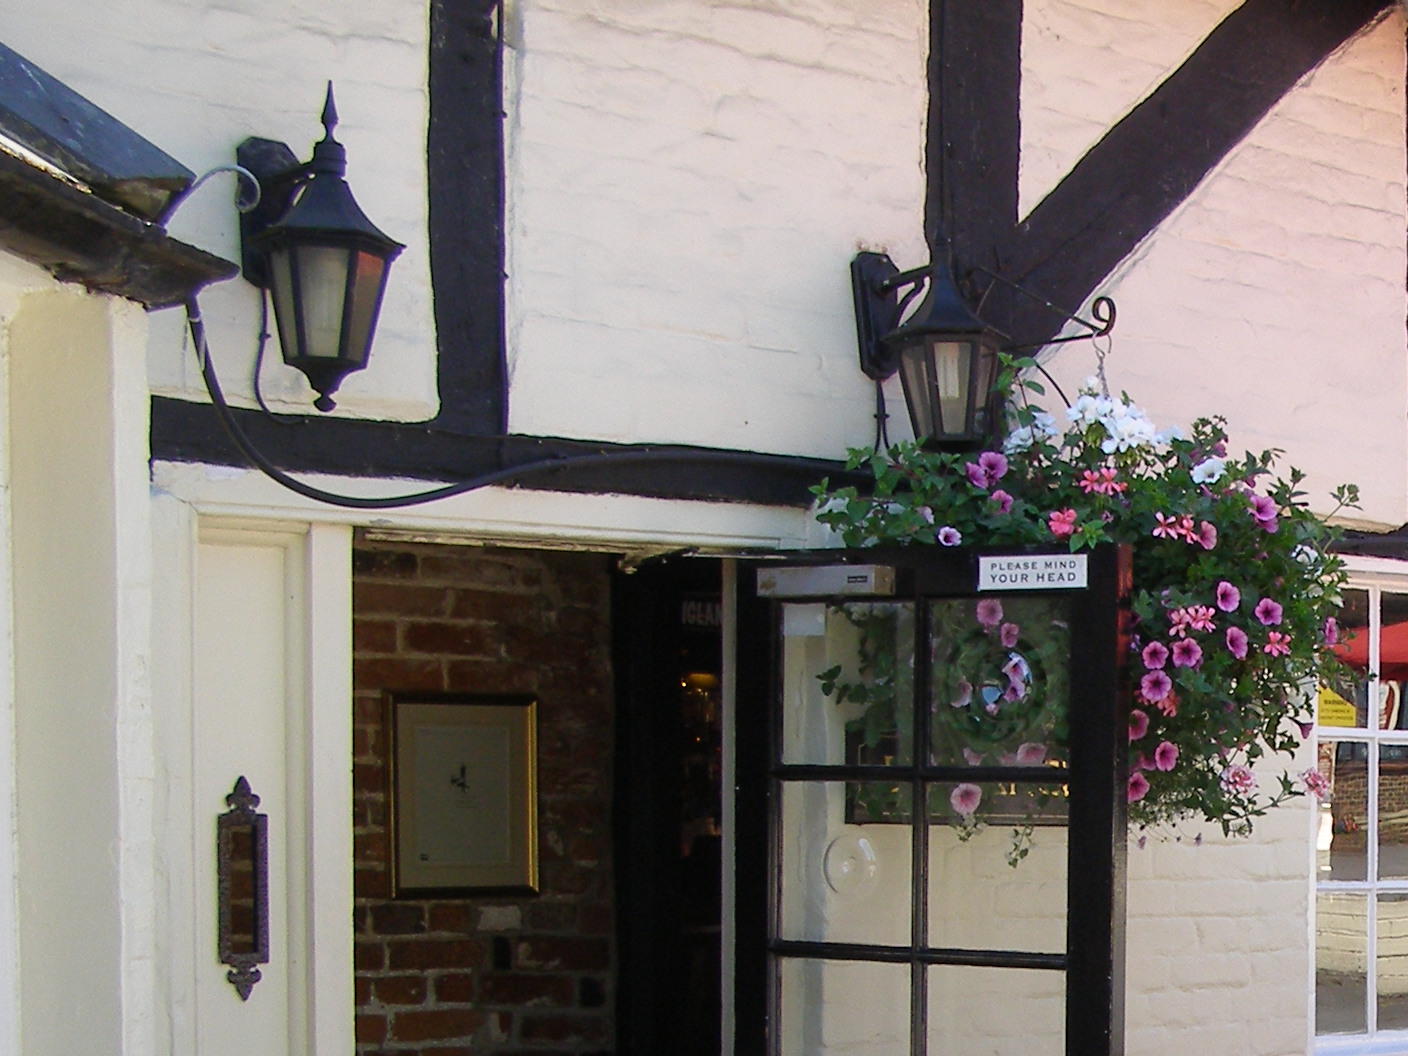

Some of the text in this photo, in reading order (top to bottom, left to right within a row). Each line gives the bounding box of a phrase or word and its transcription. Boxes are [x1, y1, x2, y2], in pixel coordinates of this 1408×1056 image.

[991, 561, 1077, 571] PLEASE MIND
[990, 573, 1077, 583] YOUR HEAD
